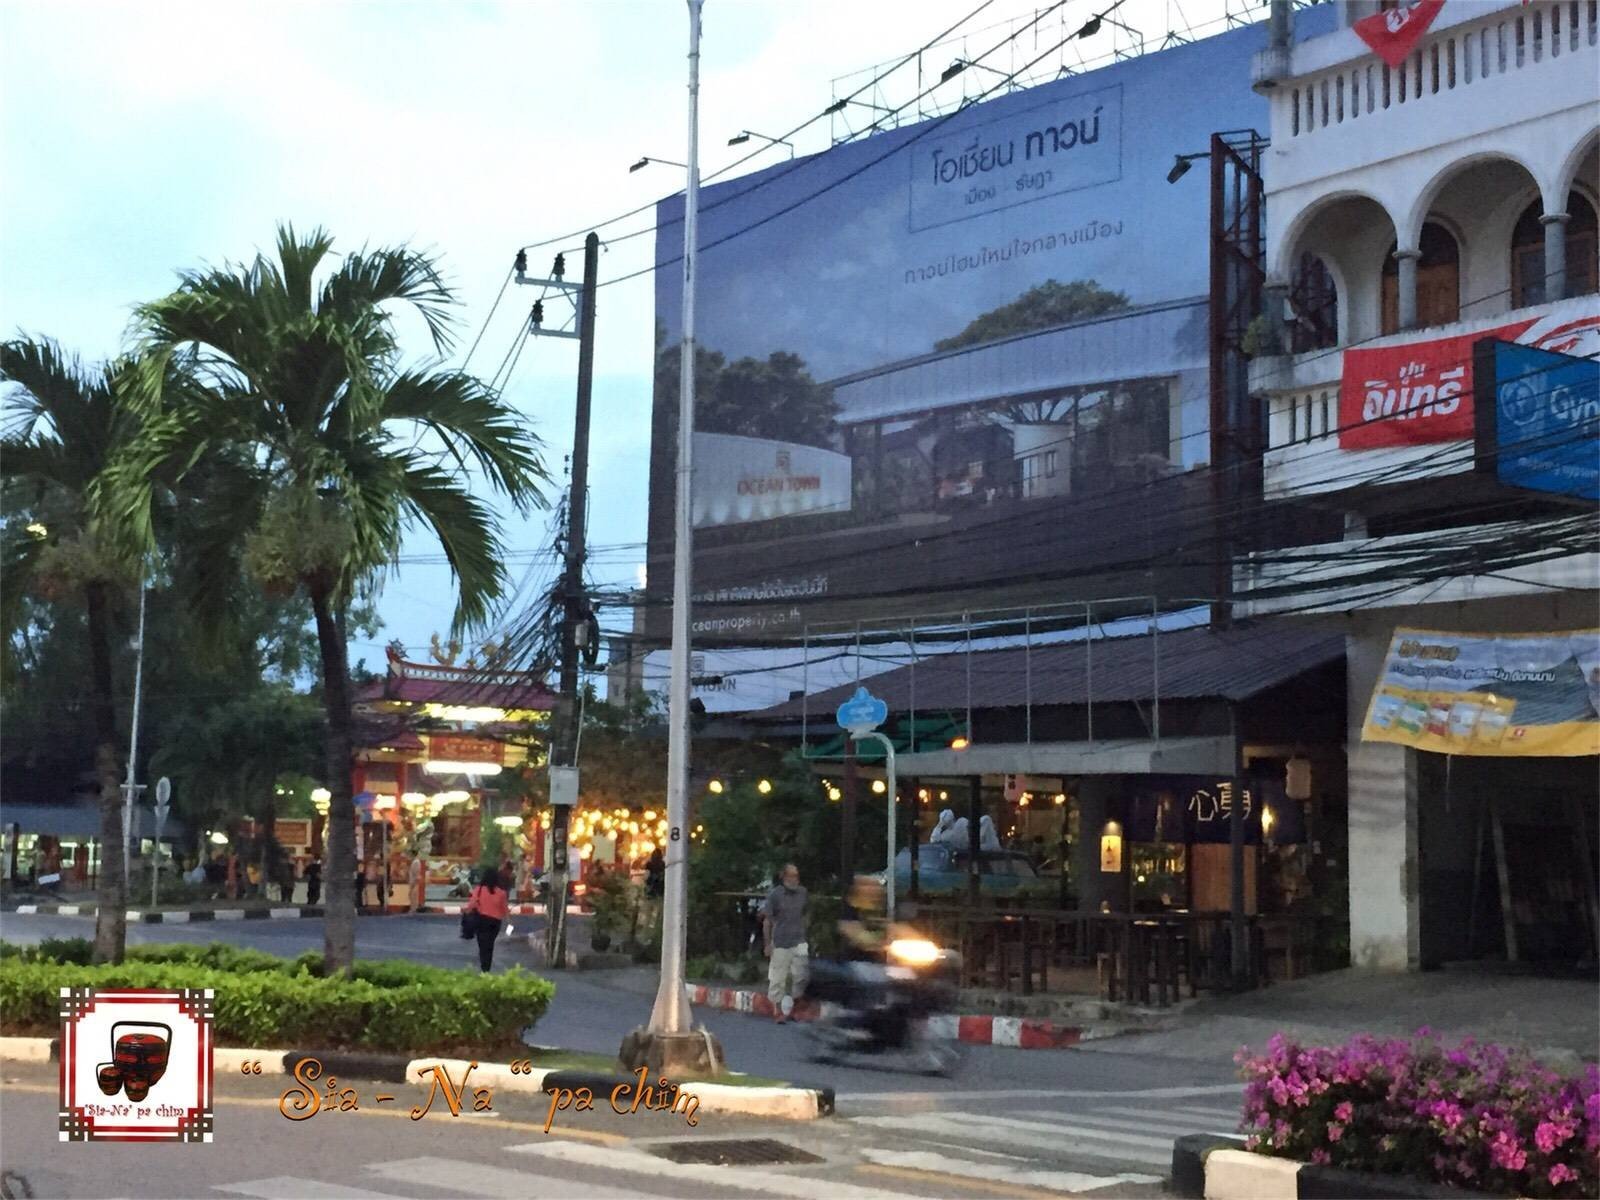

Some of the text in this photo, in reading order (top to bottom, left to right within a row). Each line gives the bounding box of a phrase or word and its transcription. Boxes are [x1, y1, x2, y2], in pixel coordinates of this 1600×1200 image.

[1024, 105, 1104, 160] ทาวน์
[1399, 361, 1426, 385] ปูน
[1362, 366, 1465, 422] อินทรี
[691, 607, 800, 634] ceanproperty.co.th
[670, 827, 680, 842] 8
